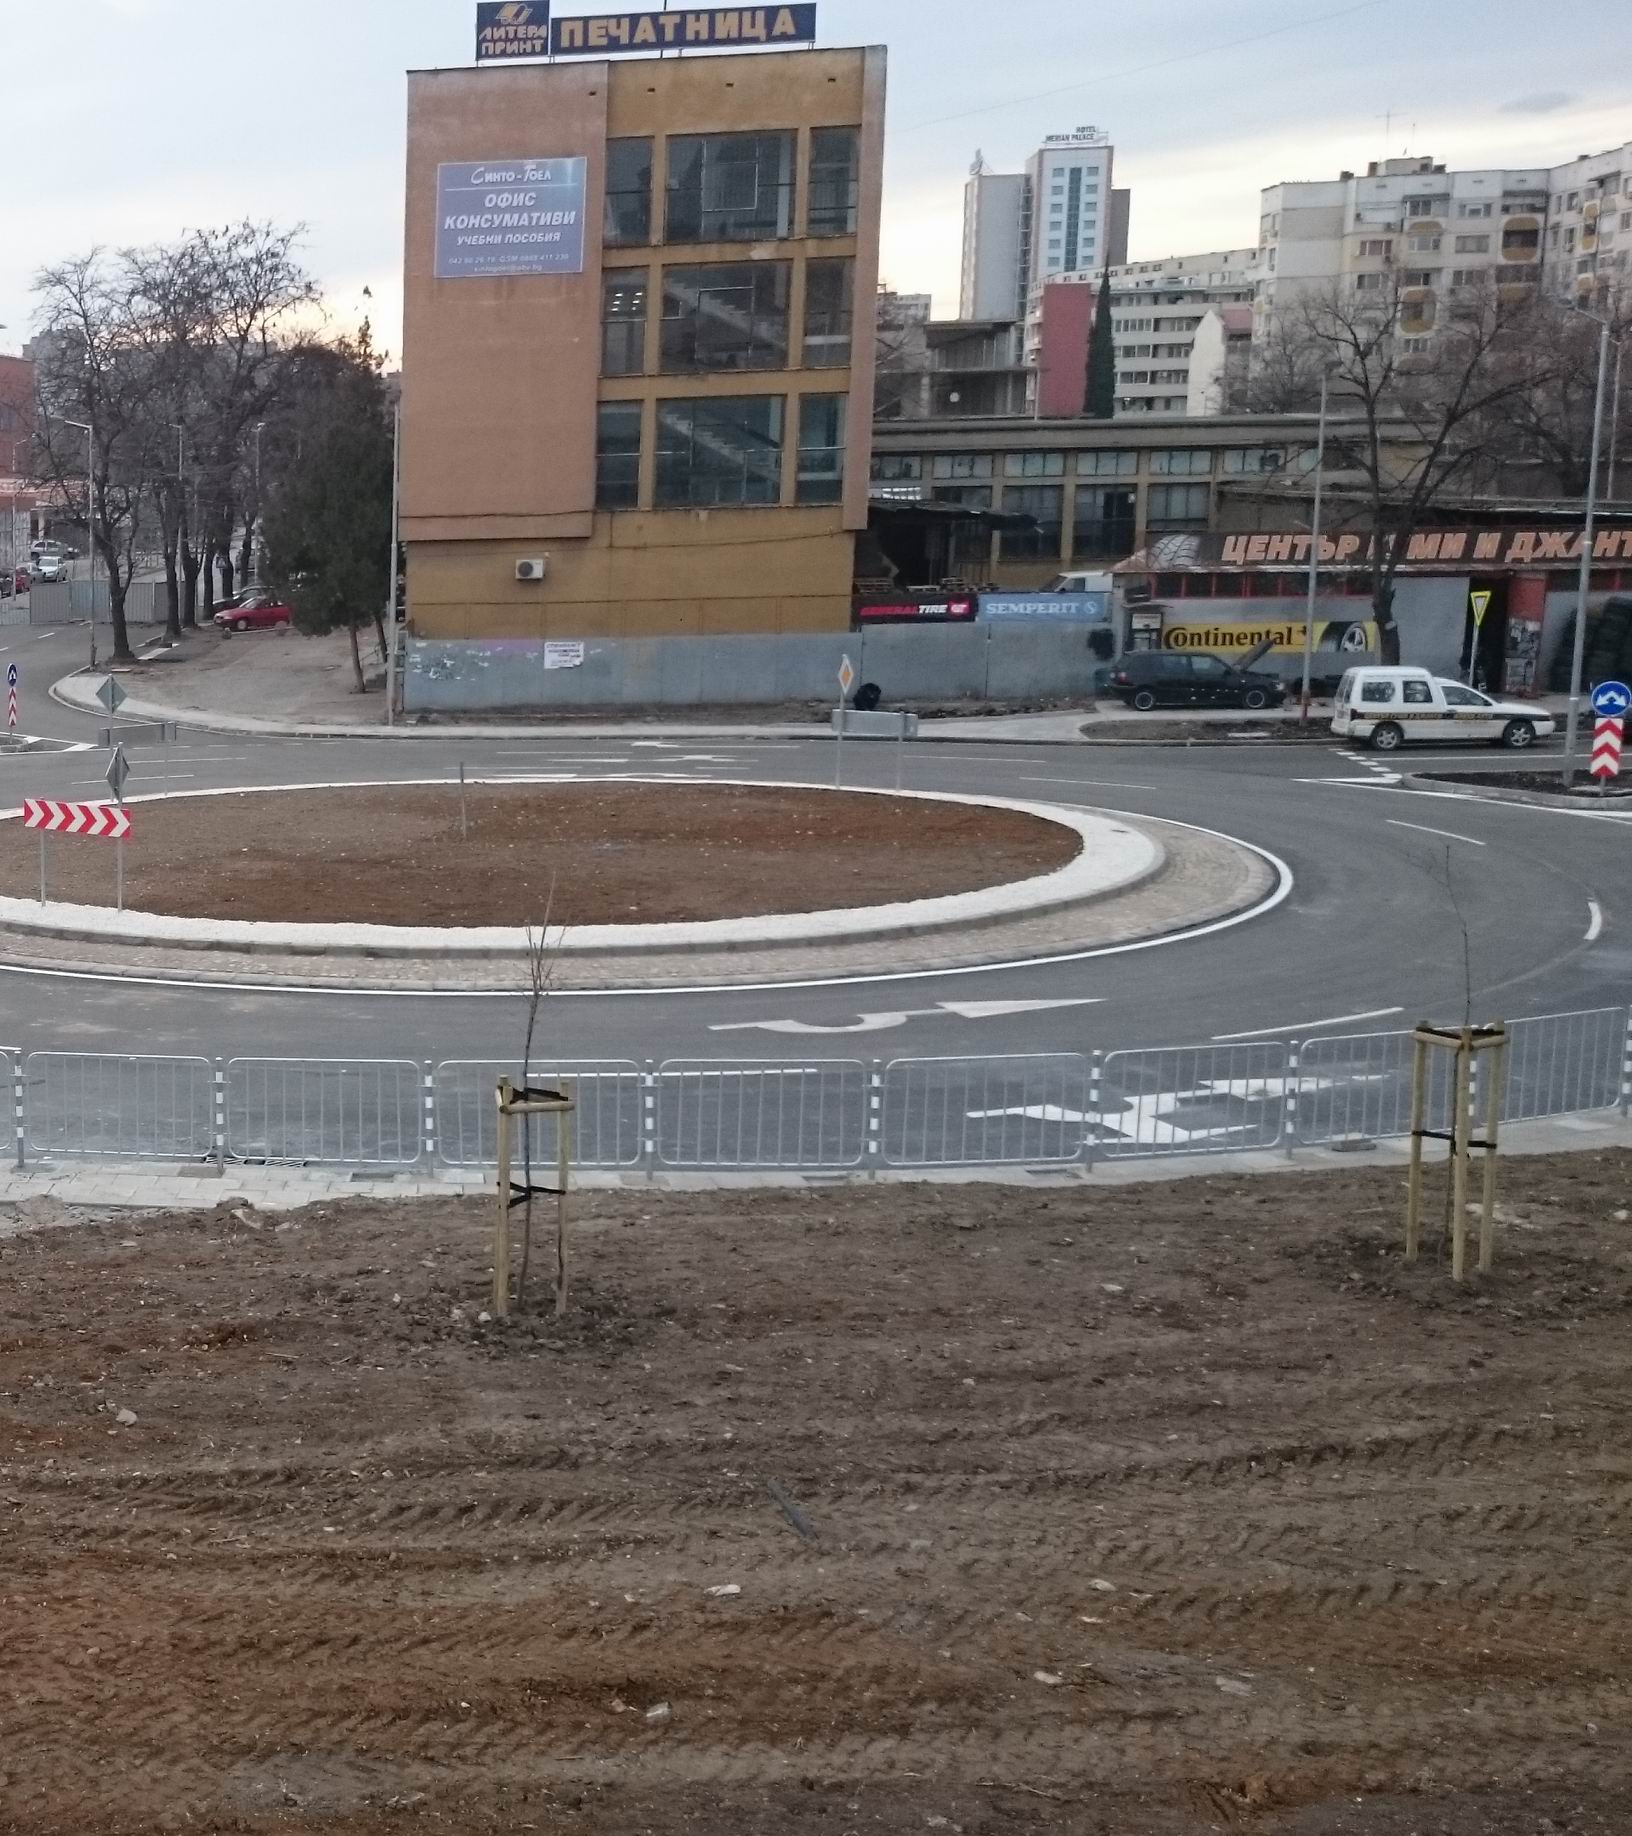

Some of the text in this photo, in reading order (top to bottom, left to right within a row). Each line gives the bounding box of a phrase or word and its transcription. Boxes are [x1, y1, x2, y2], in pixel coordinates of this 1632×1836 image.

[479, 24, 548, 41] ЛИТЕРА
[560, 8, 796, 48] ПЕЧАТНИЦА
[481, 39, 544, 55] ПРИНТ
[484, 192, 536, 208] ОФИС
[444, 211, 576, 229] КОНСУМАТИВИ
[457, 231, 561, 245] УЧЕБНИ ПОСОБИЯ
[1221, 535, 1359, 566] ЦЕНТЪР
[1472, 533, 1502, 560] И
[985, 602, 1080, 616] SEMPERIT
